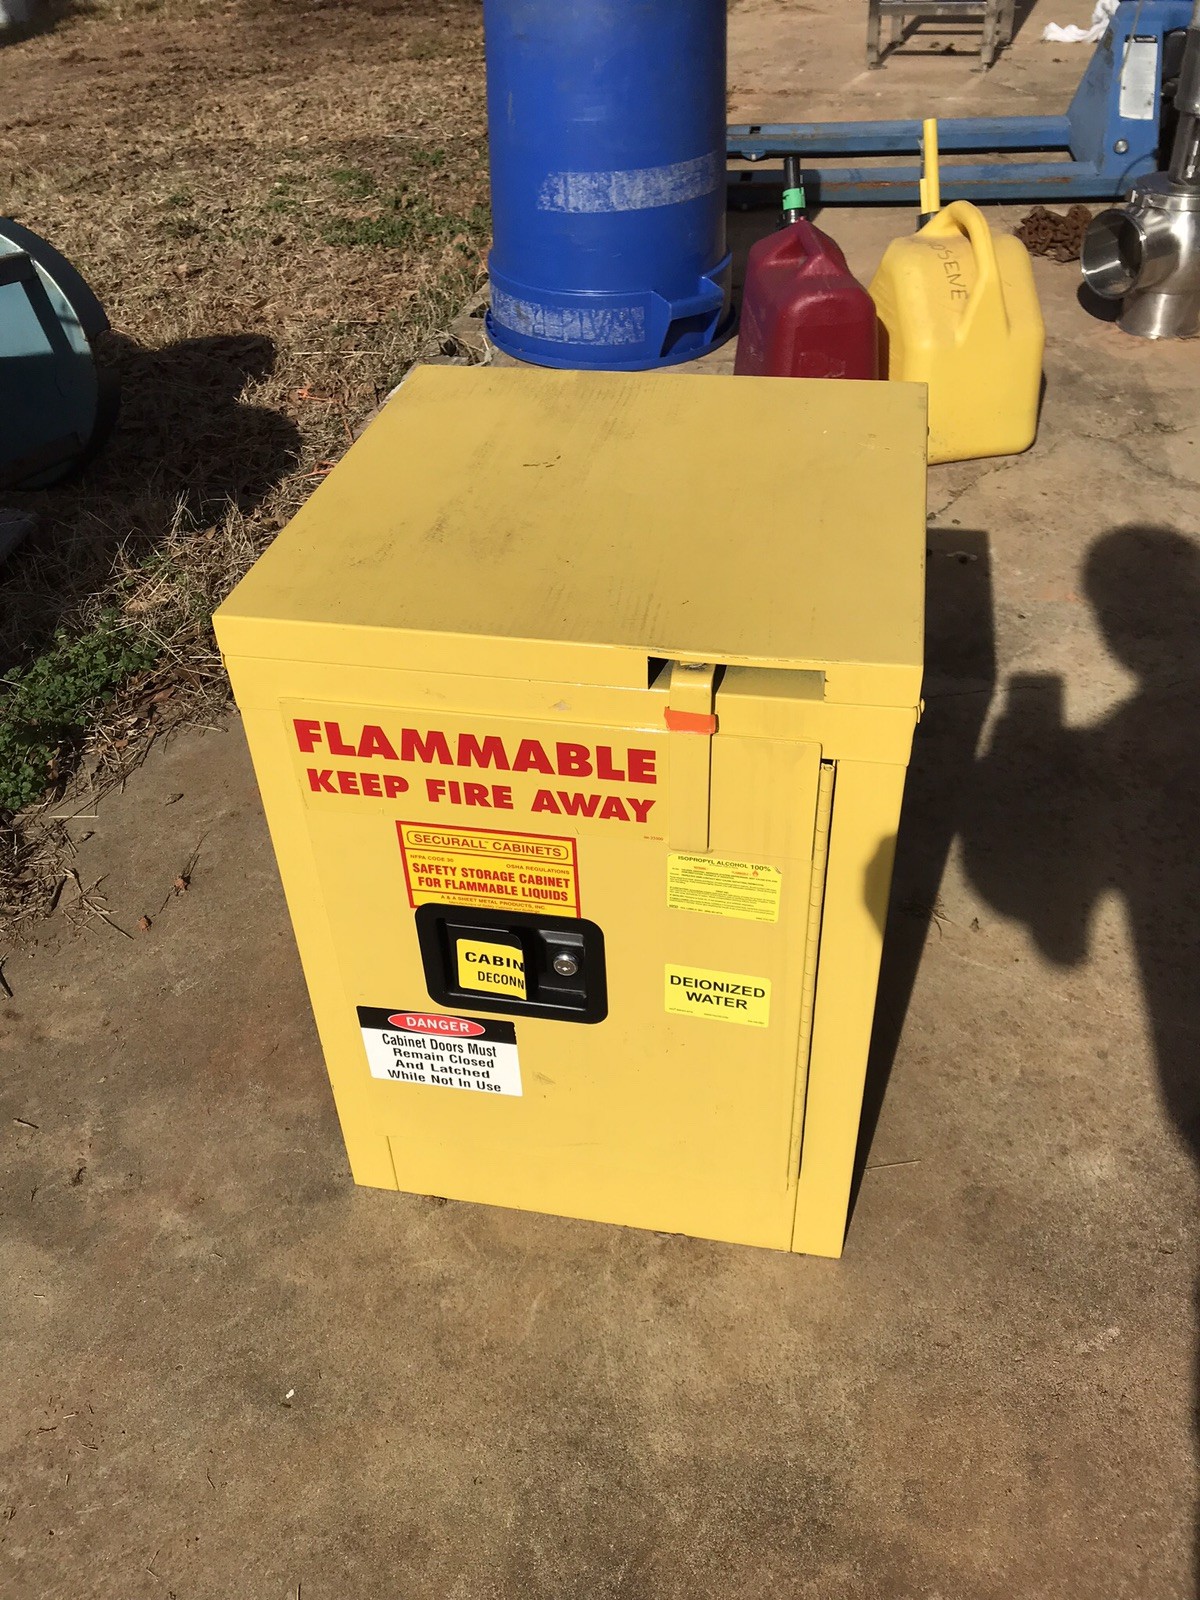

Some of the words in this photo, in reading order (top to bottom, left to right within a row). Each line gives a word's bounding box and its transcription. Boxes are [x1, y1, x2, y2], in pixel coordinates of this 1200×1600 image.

[929, 243, 969, 300] OSENE
[293, 719, 657, 784] FLAMMABLE
[306, 768, 409, 799] KEEP
[425, 779, 514, 810] FIRE
[531, 789, 656, 823] AWAY
[493, 842, 562, 857] CABINETS
[525, 865, 570, 875] REGULATIONS
[678, 855, 714, 865] ISOPROPYL
[716, 860, 748, 869] ALCOHOL
[750, 864, 771, 872] 100%
[412, 862, 457, 877] SAFETY
[461, 867, 515, 883] STORAGE
[519, 873, 570, 889] CABINET
[418, 876, 441, 888] FOR
[445, 879, 518, 896] FLAMMABLE
[521, 887, 568, 901] LIQUIDS
[479, 898, 498, 906] METAL
[465, 951, 524, 973] CABIN
[670, 975, 766, 998] DEIONIZED
[686, 991, 748, 1010] WATER
[405, 1016, 470, 1033] DANGER
[382, 1033, 427, 1049] Cabinet
[430, 1038, 464, 1054] Doors
[468, 1043, 497, 1058] Must
[393, 1048, 444, 1062] Remain
[449, 1054, 495, 1068] Closed
[395, 1059, 424, 1071] And
[431, 1063, 490, 1079] Latched
[387, 1069, 426, 1083] While
[431, 1074, 453, 1086] Not
[459, 1078, 471, 1088] In
[476, 1080, 501, 1092] Use
